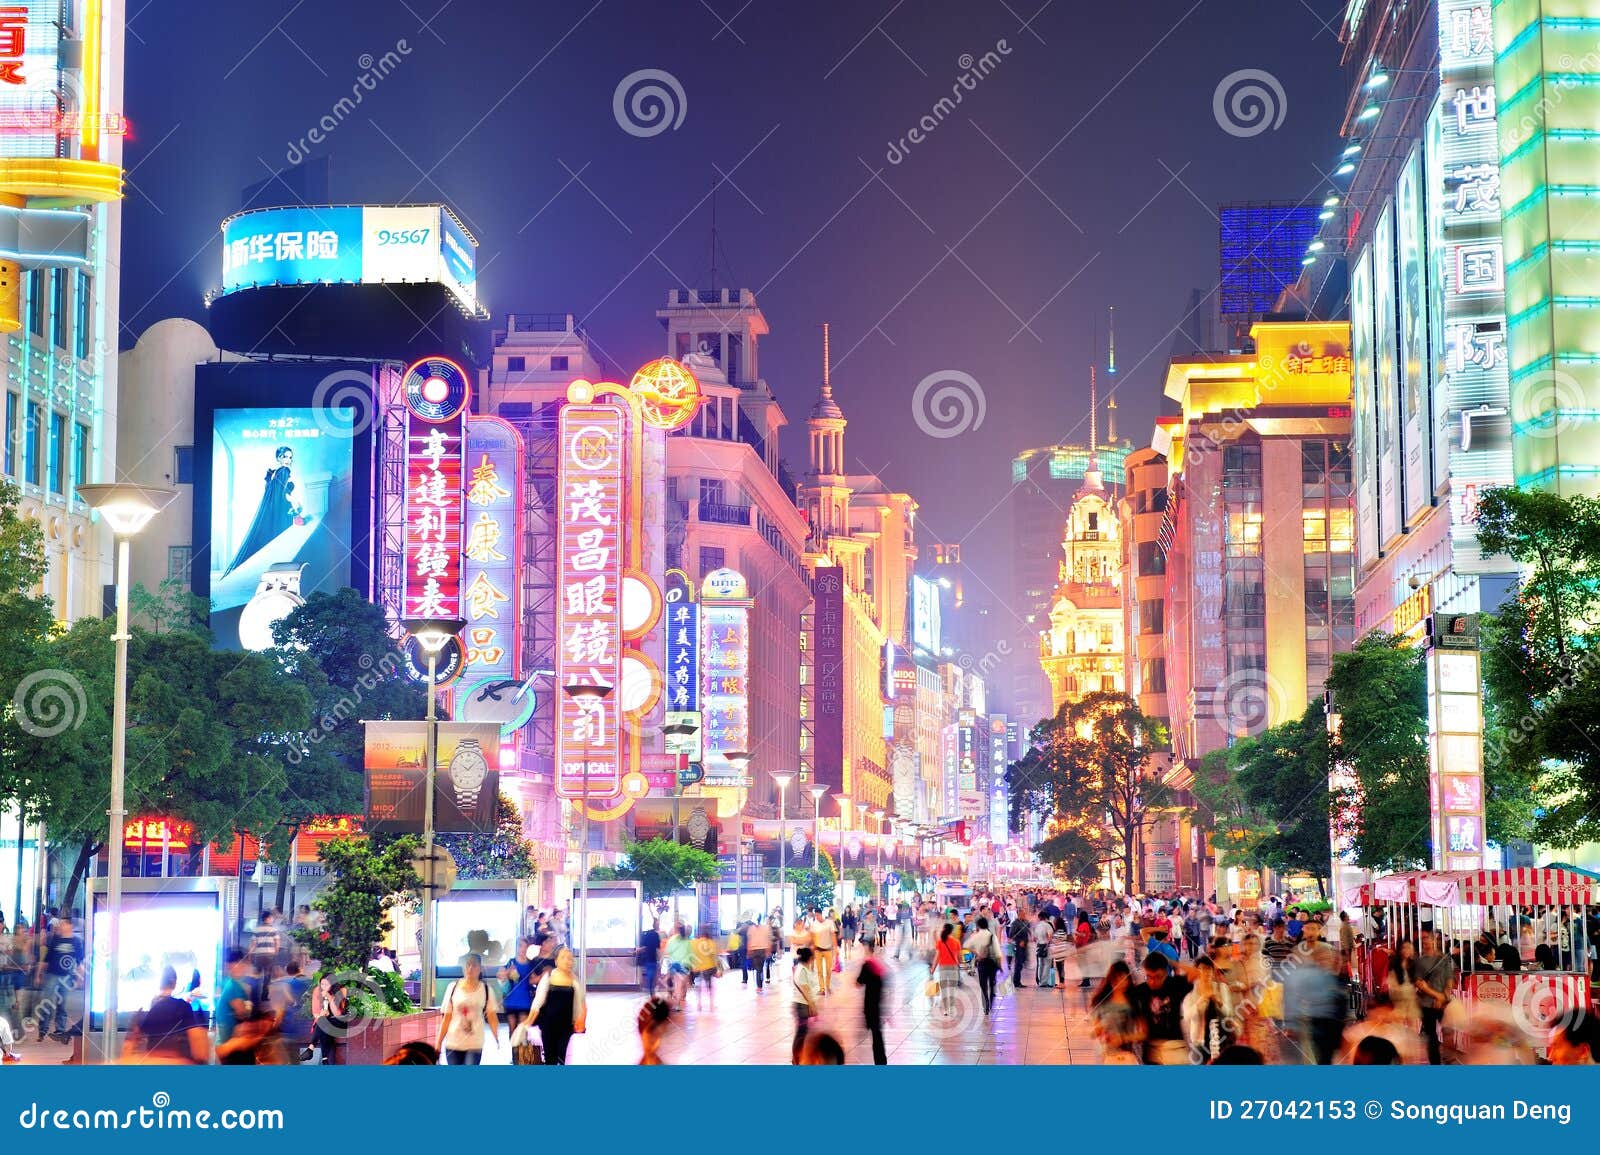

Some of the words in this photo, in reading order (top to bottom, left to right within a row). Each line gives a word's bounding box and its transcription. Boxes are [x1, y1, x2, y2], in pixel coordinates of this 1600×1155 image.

[378, 228, 430, 246] 95567
[231, 230, 339, 271] 新华保险
[1451, 8, 1507, 525] 联世茂国际广
[465, 454, 511, 666] 泰康食品
[893, 669, 916, 680] MIDO
[564, 763, 612, 775] OPTICAL
[373, 803, 395, 812] MIDO
